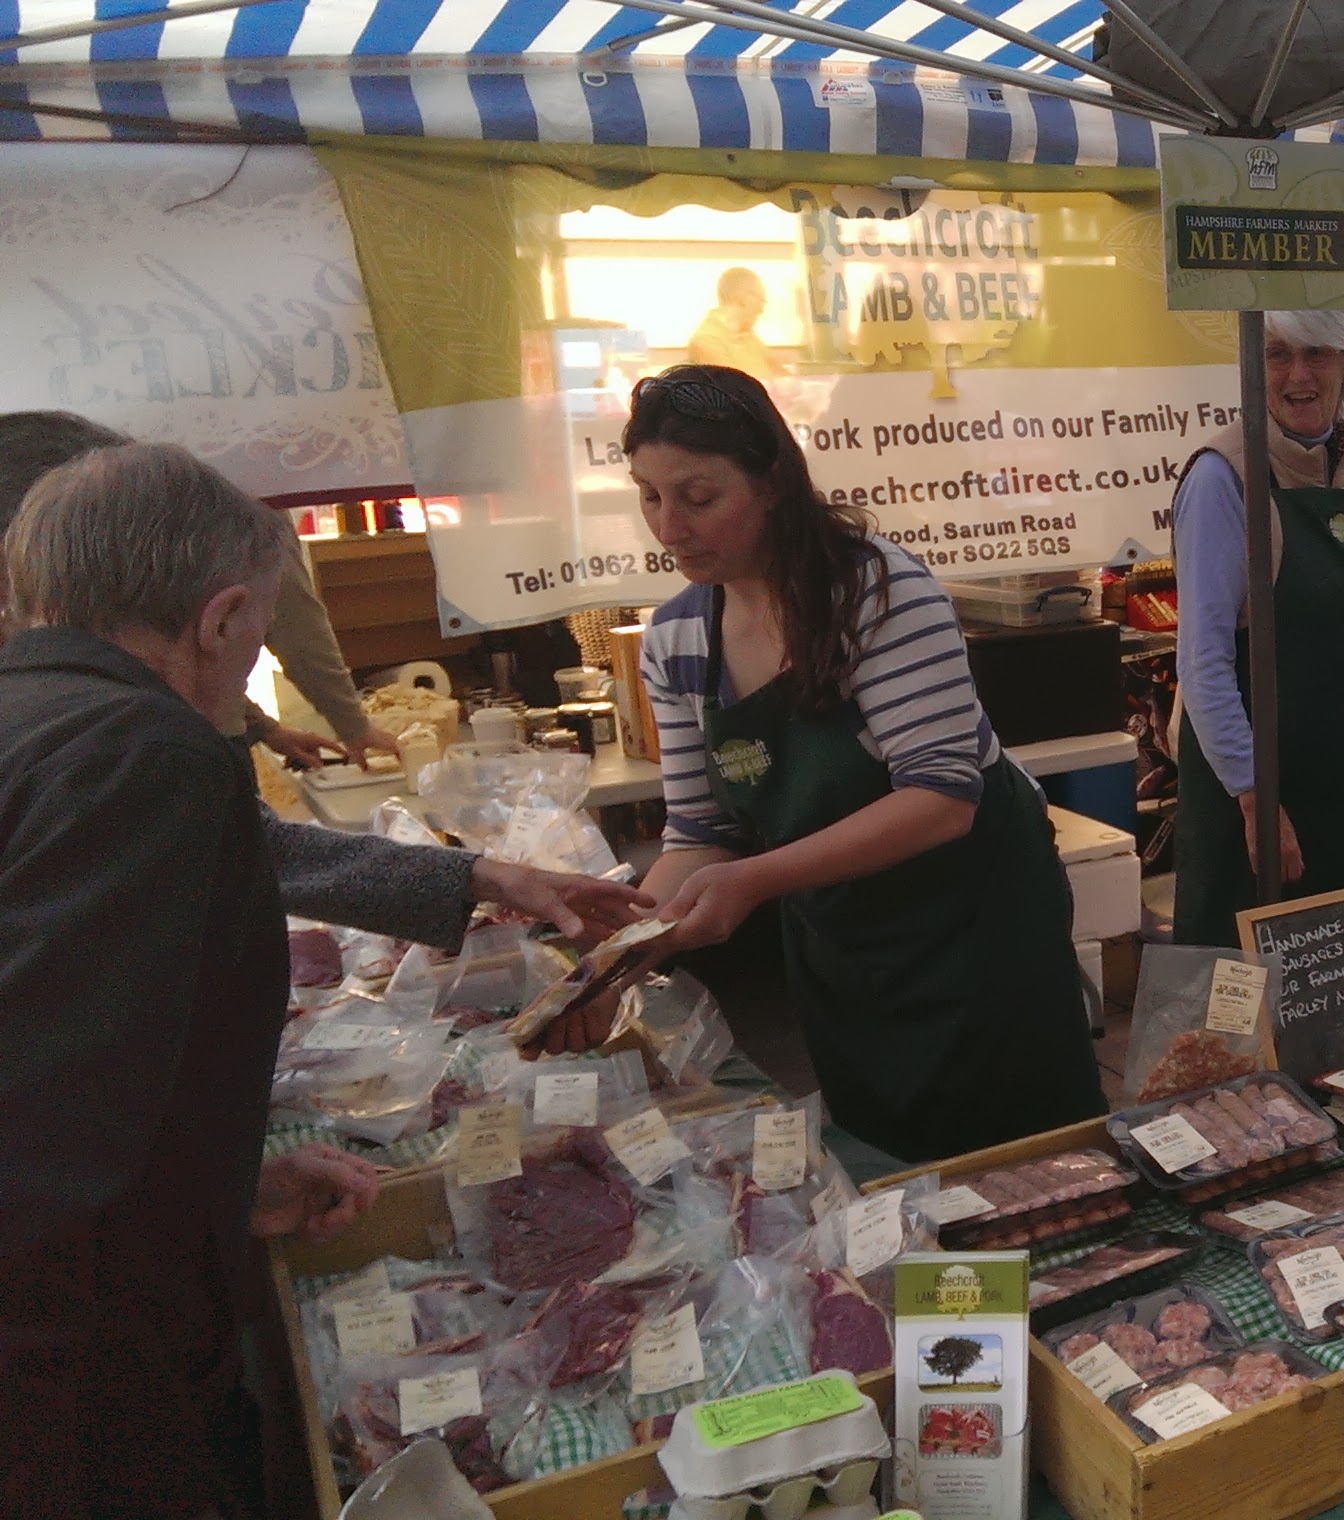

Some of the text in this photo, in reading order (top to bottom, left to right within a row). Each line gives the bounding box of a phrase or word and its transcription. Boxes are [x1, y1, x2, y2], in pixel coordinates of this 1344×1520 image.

[1185, 215, 1339, 232] HAMPSHIRE FARMERS MARKETS
[1188, 231, 1339, 265] MEMBER
[922, 272, 950, 321] &
[584, 436, 631, 467] La
[873, 410, 1005, 456] produced
[1012, 413, 1045, 439] on
[1052, 414, 1094, 438] our
[1101, 404, 1190, 437] Family
[1196, 402, 1241, 427] Far
[943, 519, 1016, 540] Sarum
[1020, 512, 1077, 533] Road
[915, 536, 1072, 566] ster SO22 5QS
[505, 551, 680, 595] Tel: 01962 86
[1256, 918, 1344, 956] HANDMADE
[1281, 941, 1344, 977] SAUSAGES
[1277, 994, 1329, 1030] FARLEY
[934, 1273, 985, 1287] Beechcroft
[946, 1290, 968, 1303] BEEF
